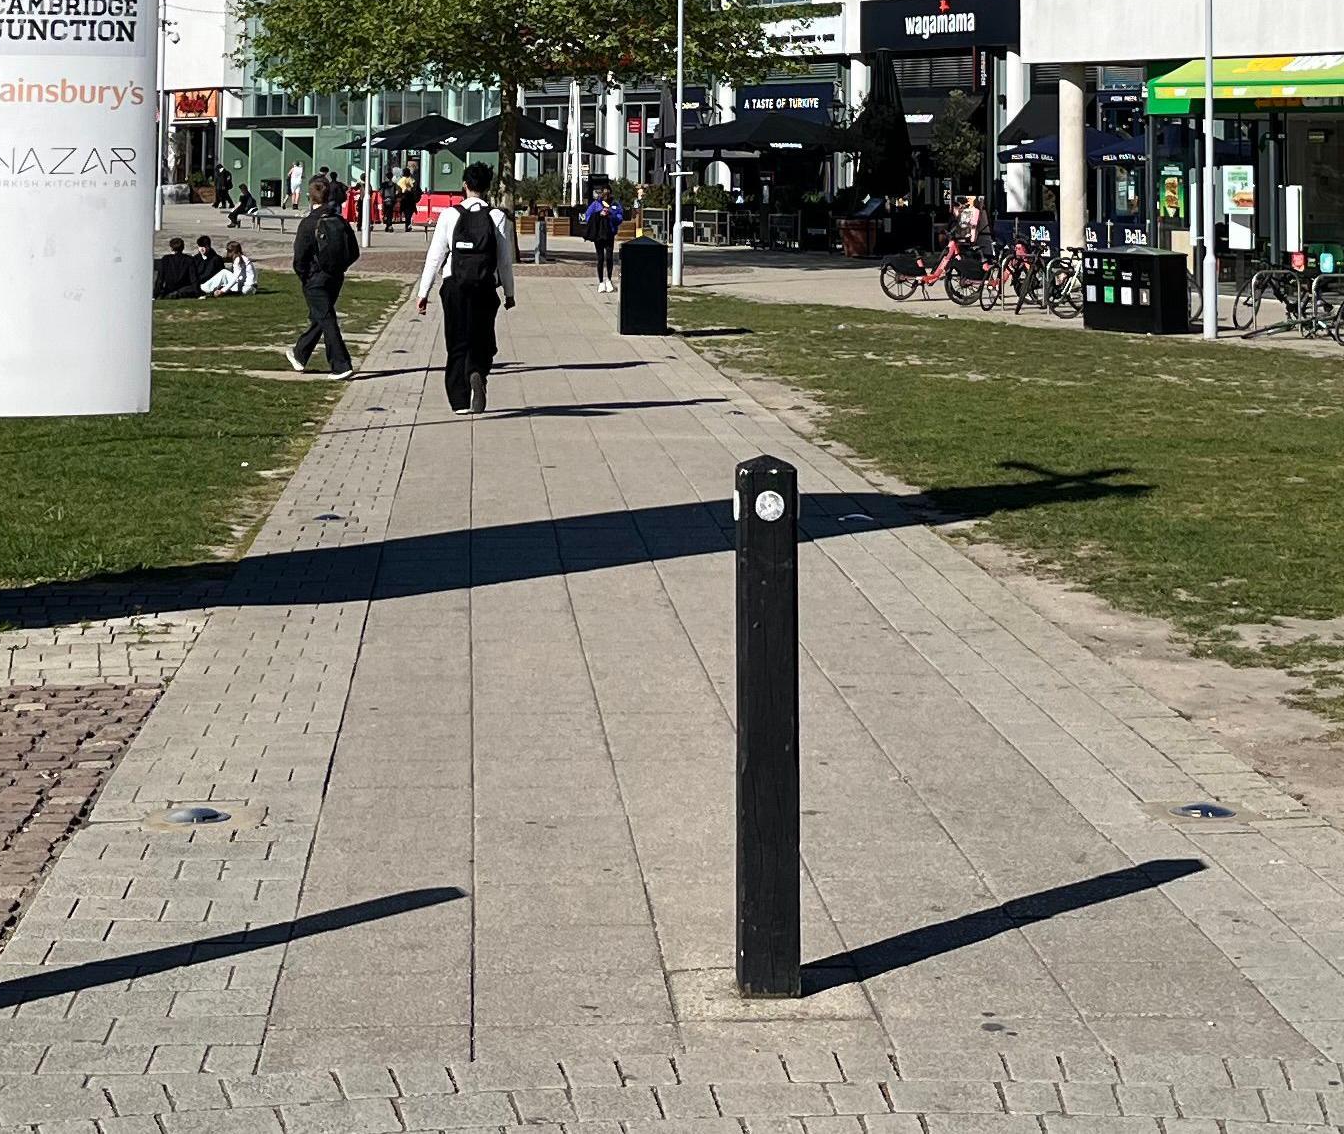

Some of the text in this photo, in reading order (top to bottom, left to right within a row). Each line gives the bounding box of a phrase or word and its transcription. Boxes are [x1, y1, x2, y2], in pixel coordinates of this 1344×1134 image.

[905, 12, 975, 39] wagamama
[744, 99, 750, 109] A
[752, 98, 773, 109] TASTE
[776, 98, 786, 109] OF
[45, 180, 97, 189] KITCHEN
[114, 179, 137, 188] BAR
[1030, 226, 1051, 241] Bella
[1125, 228, 1147, 245] Bella
